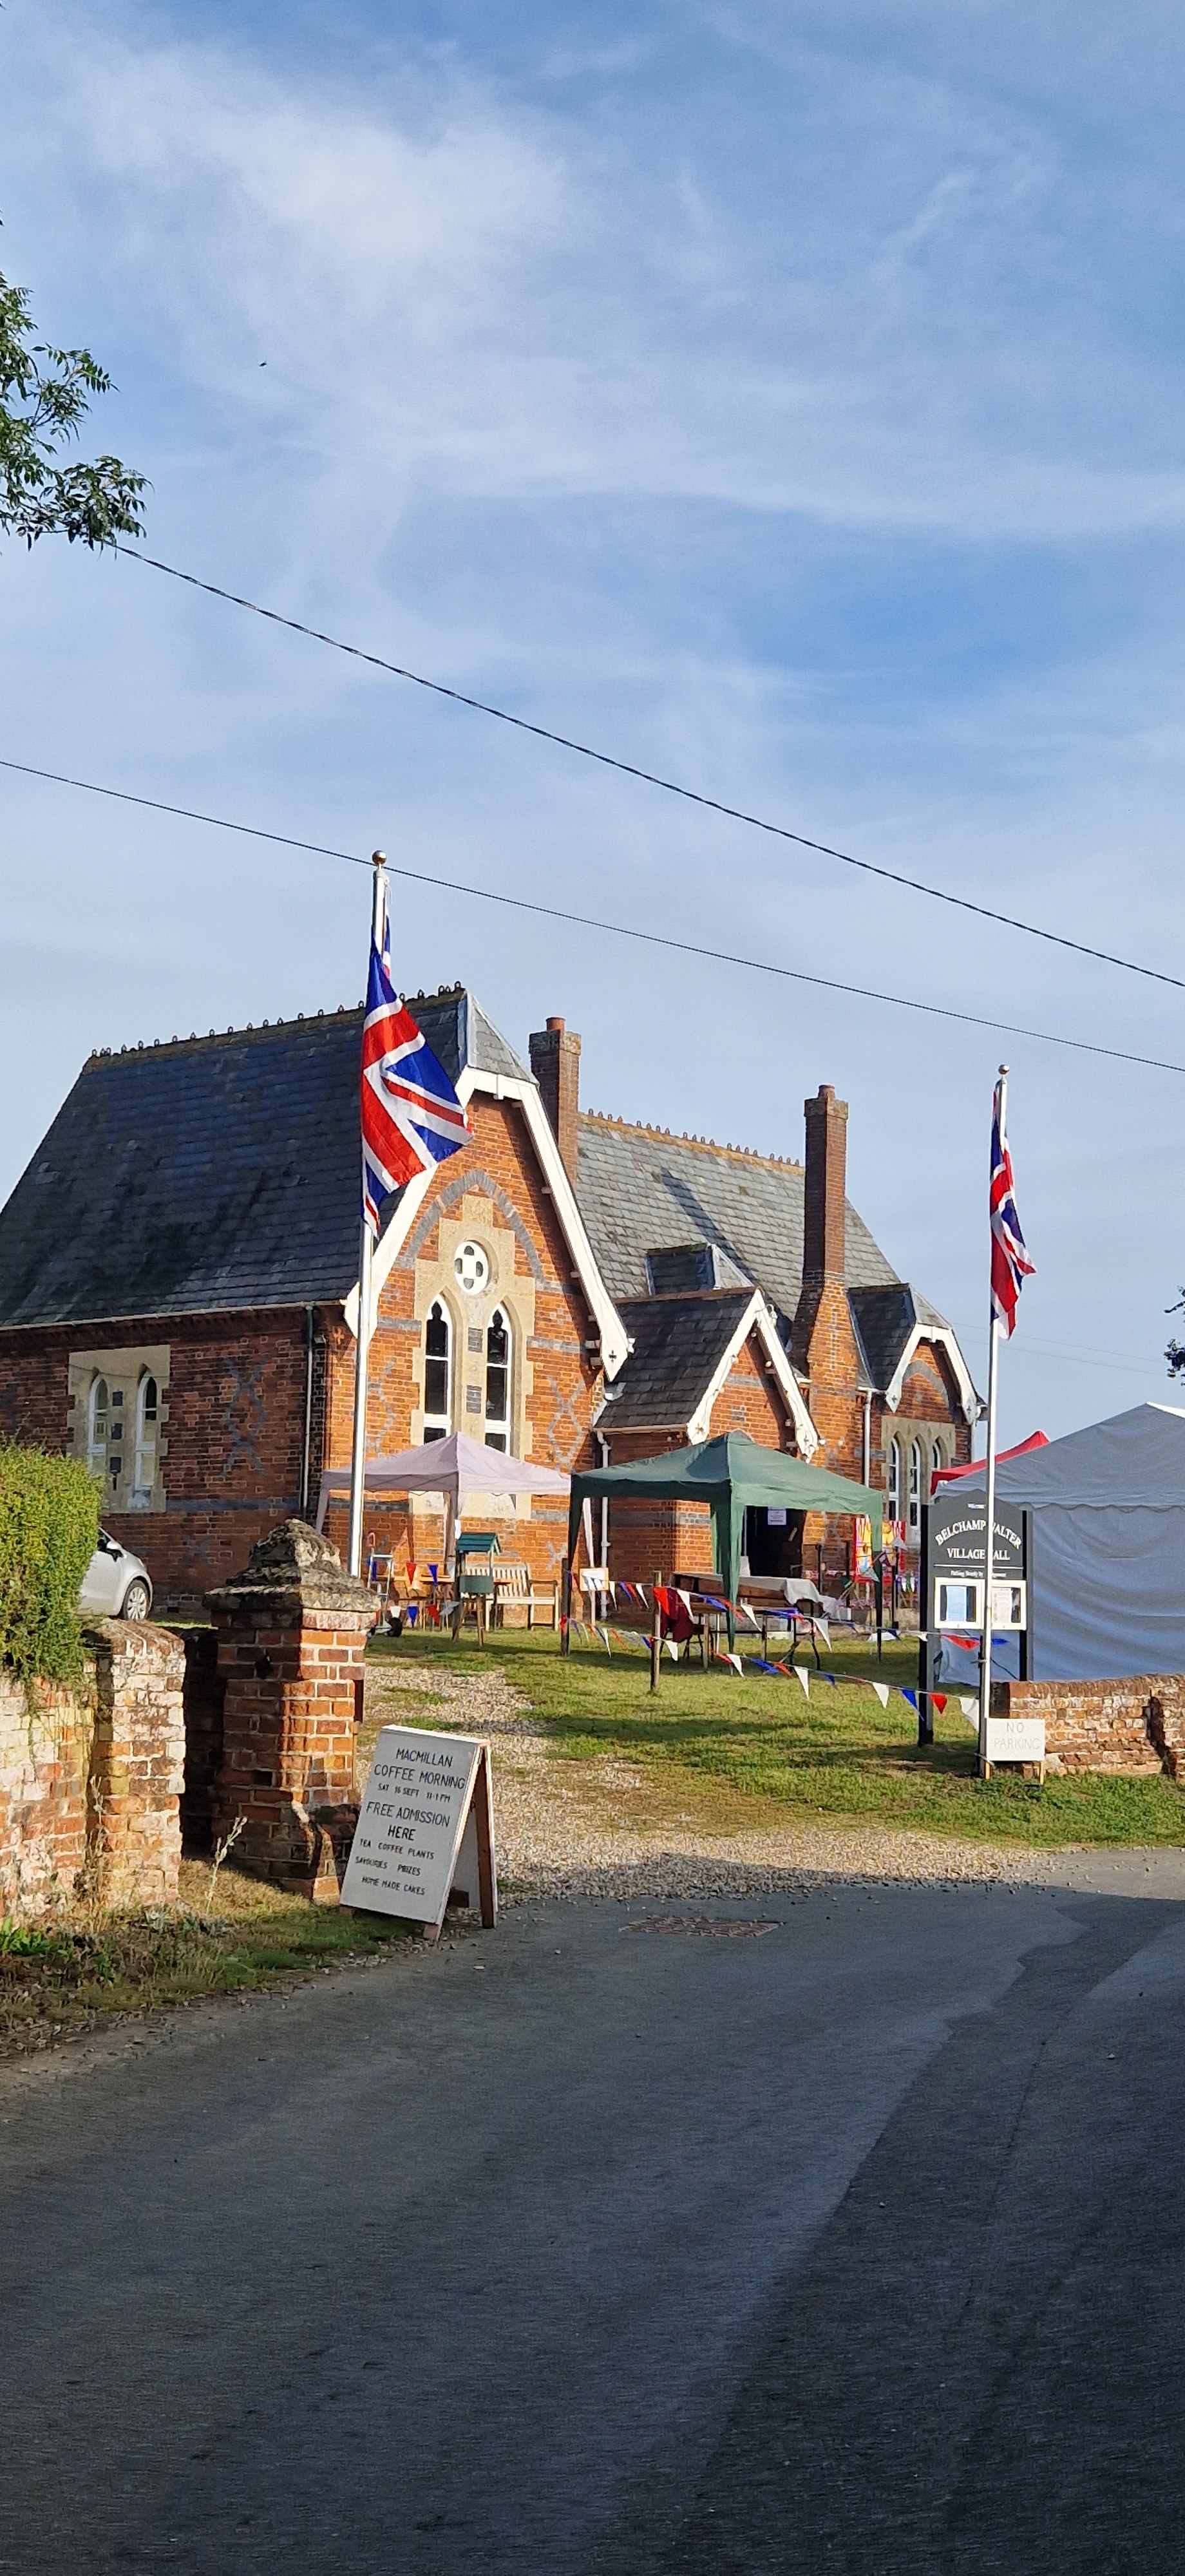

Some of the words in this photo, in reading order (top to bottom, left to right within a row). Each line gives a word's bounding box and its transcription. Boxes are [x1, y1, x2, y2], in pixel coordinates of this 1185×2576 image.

[934, 1519, 987, 1546] BELCHAMP
[947, 1548, 985, 1559] VILLAGE
[992, 1549, 1010, 1560] ALL
[1007, 1722, 1024, 1733] NO
[994, 1738, 1039, 1750] PARKING
[395, 1748, 453, 1768] MACMILLAN
[374, 1764, 415, 1781] COFFEE
[419, 1770, 466, 1789] MORNING
[377, 1783, 390, 1791] SAT
[366, 1801, 395, 1817] FREE
[395, 1806, 450, 1828] ADMISSION
[388, 1824, 416, 1841] HERE
[360, 1839, 371, 1848] TEA
[378, 1842, 403, 1854] COFFEE
[408, 1848, 435, 1860] PLANTS
[382, 1880, 401, 1891] MADE
[404, 1884, 425, 1895] CAKES
